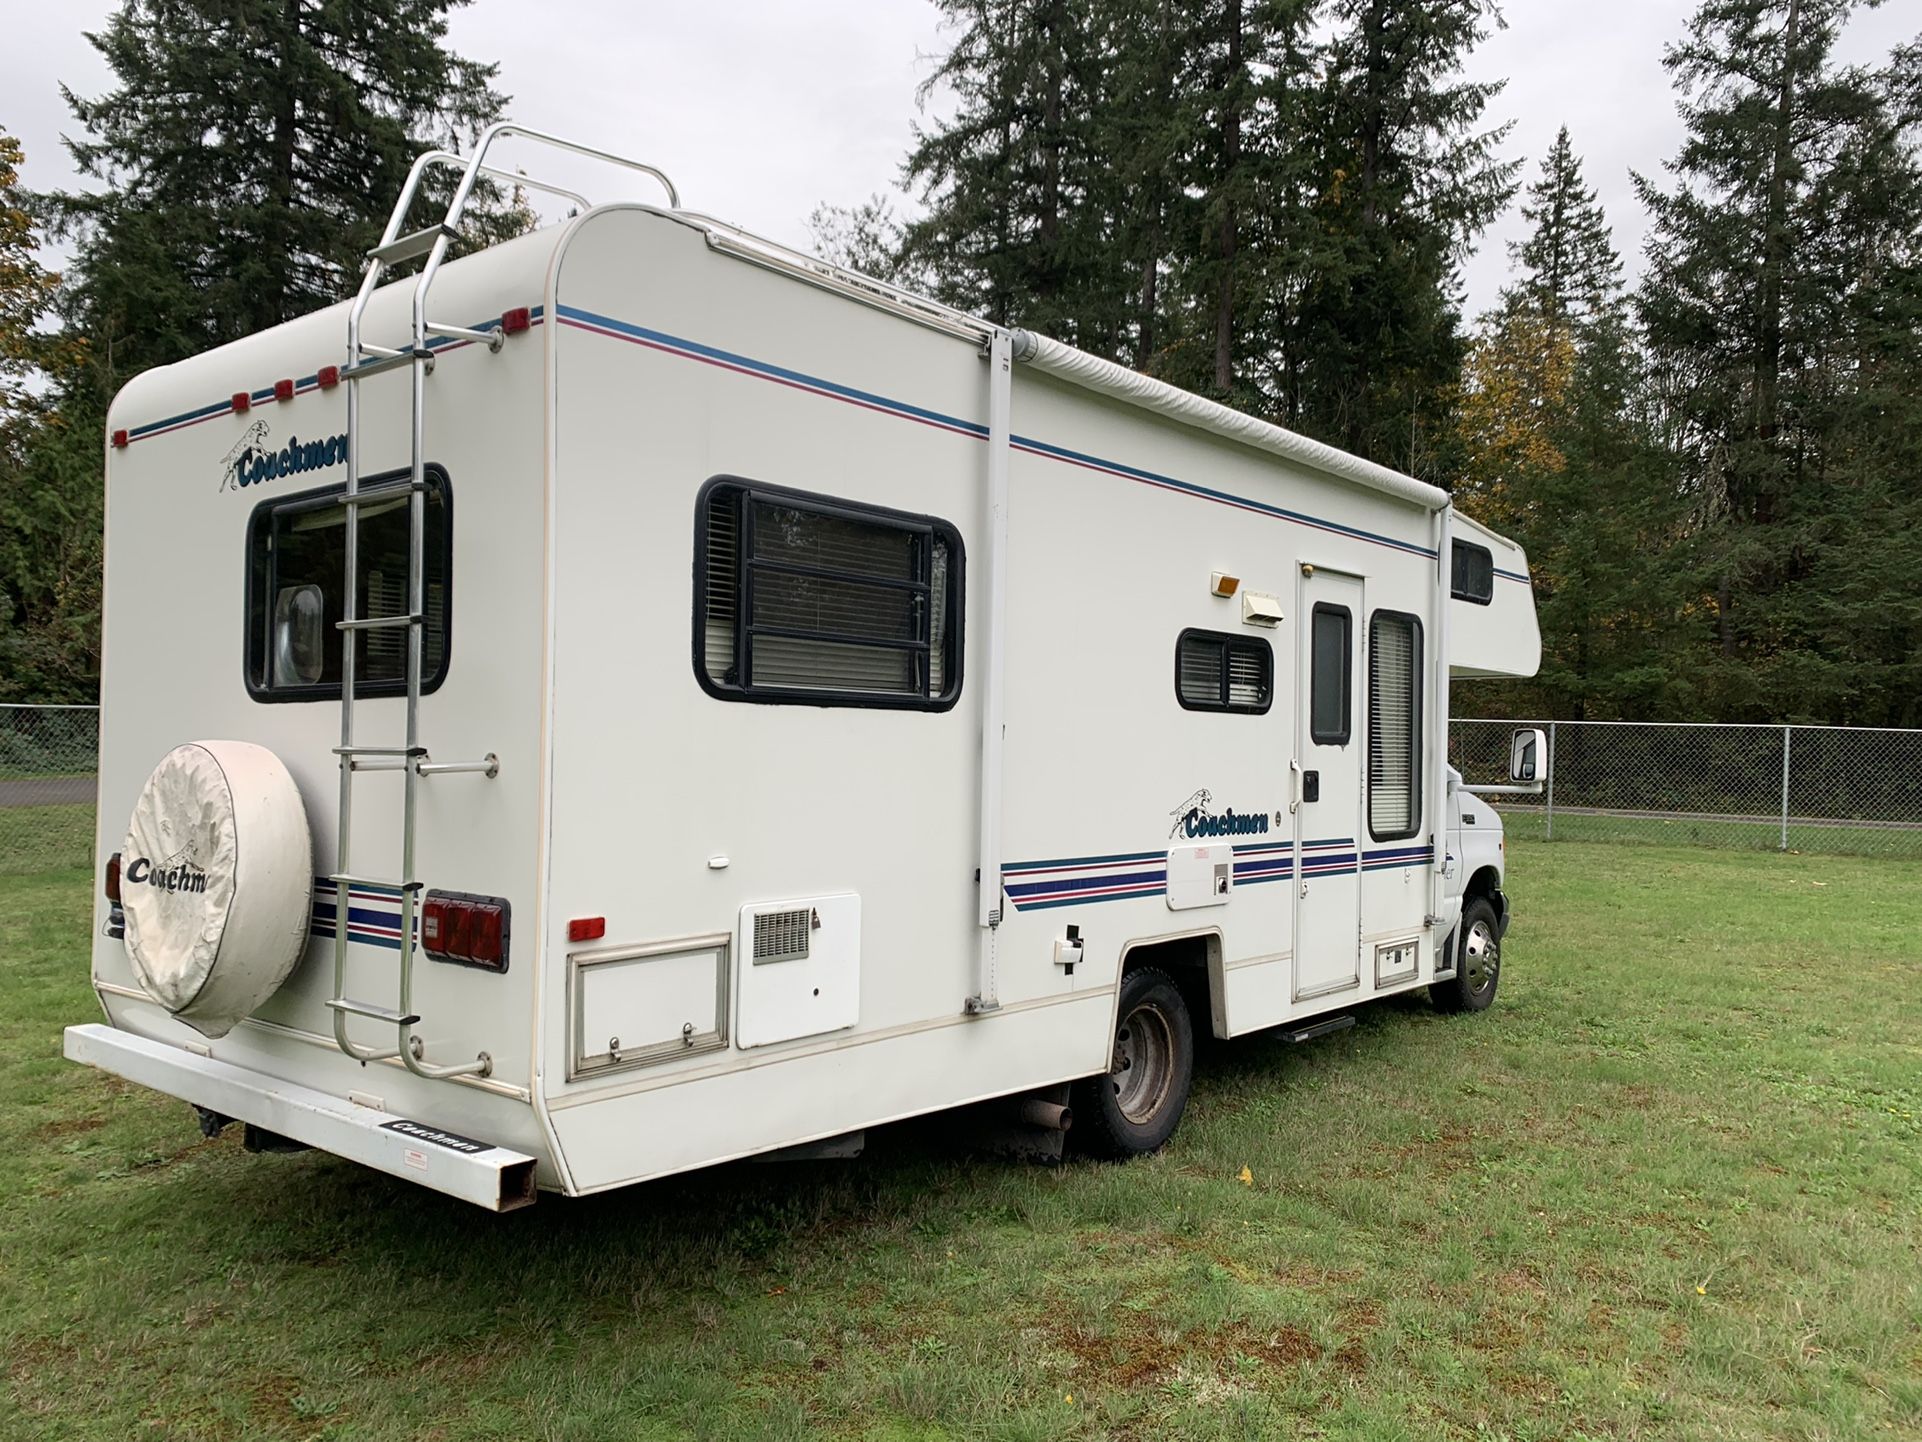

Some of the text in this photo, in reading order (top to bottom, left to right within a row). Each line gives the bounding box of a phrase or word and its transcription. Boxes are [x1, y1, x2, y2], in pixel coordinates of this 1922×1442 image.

[237, 433, 348, 487] Coachmen
[1184, 807, 1269, 838] Coachmen
[127, 857, 211, 893] Coachm
